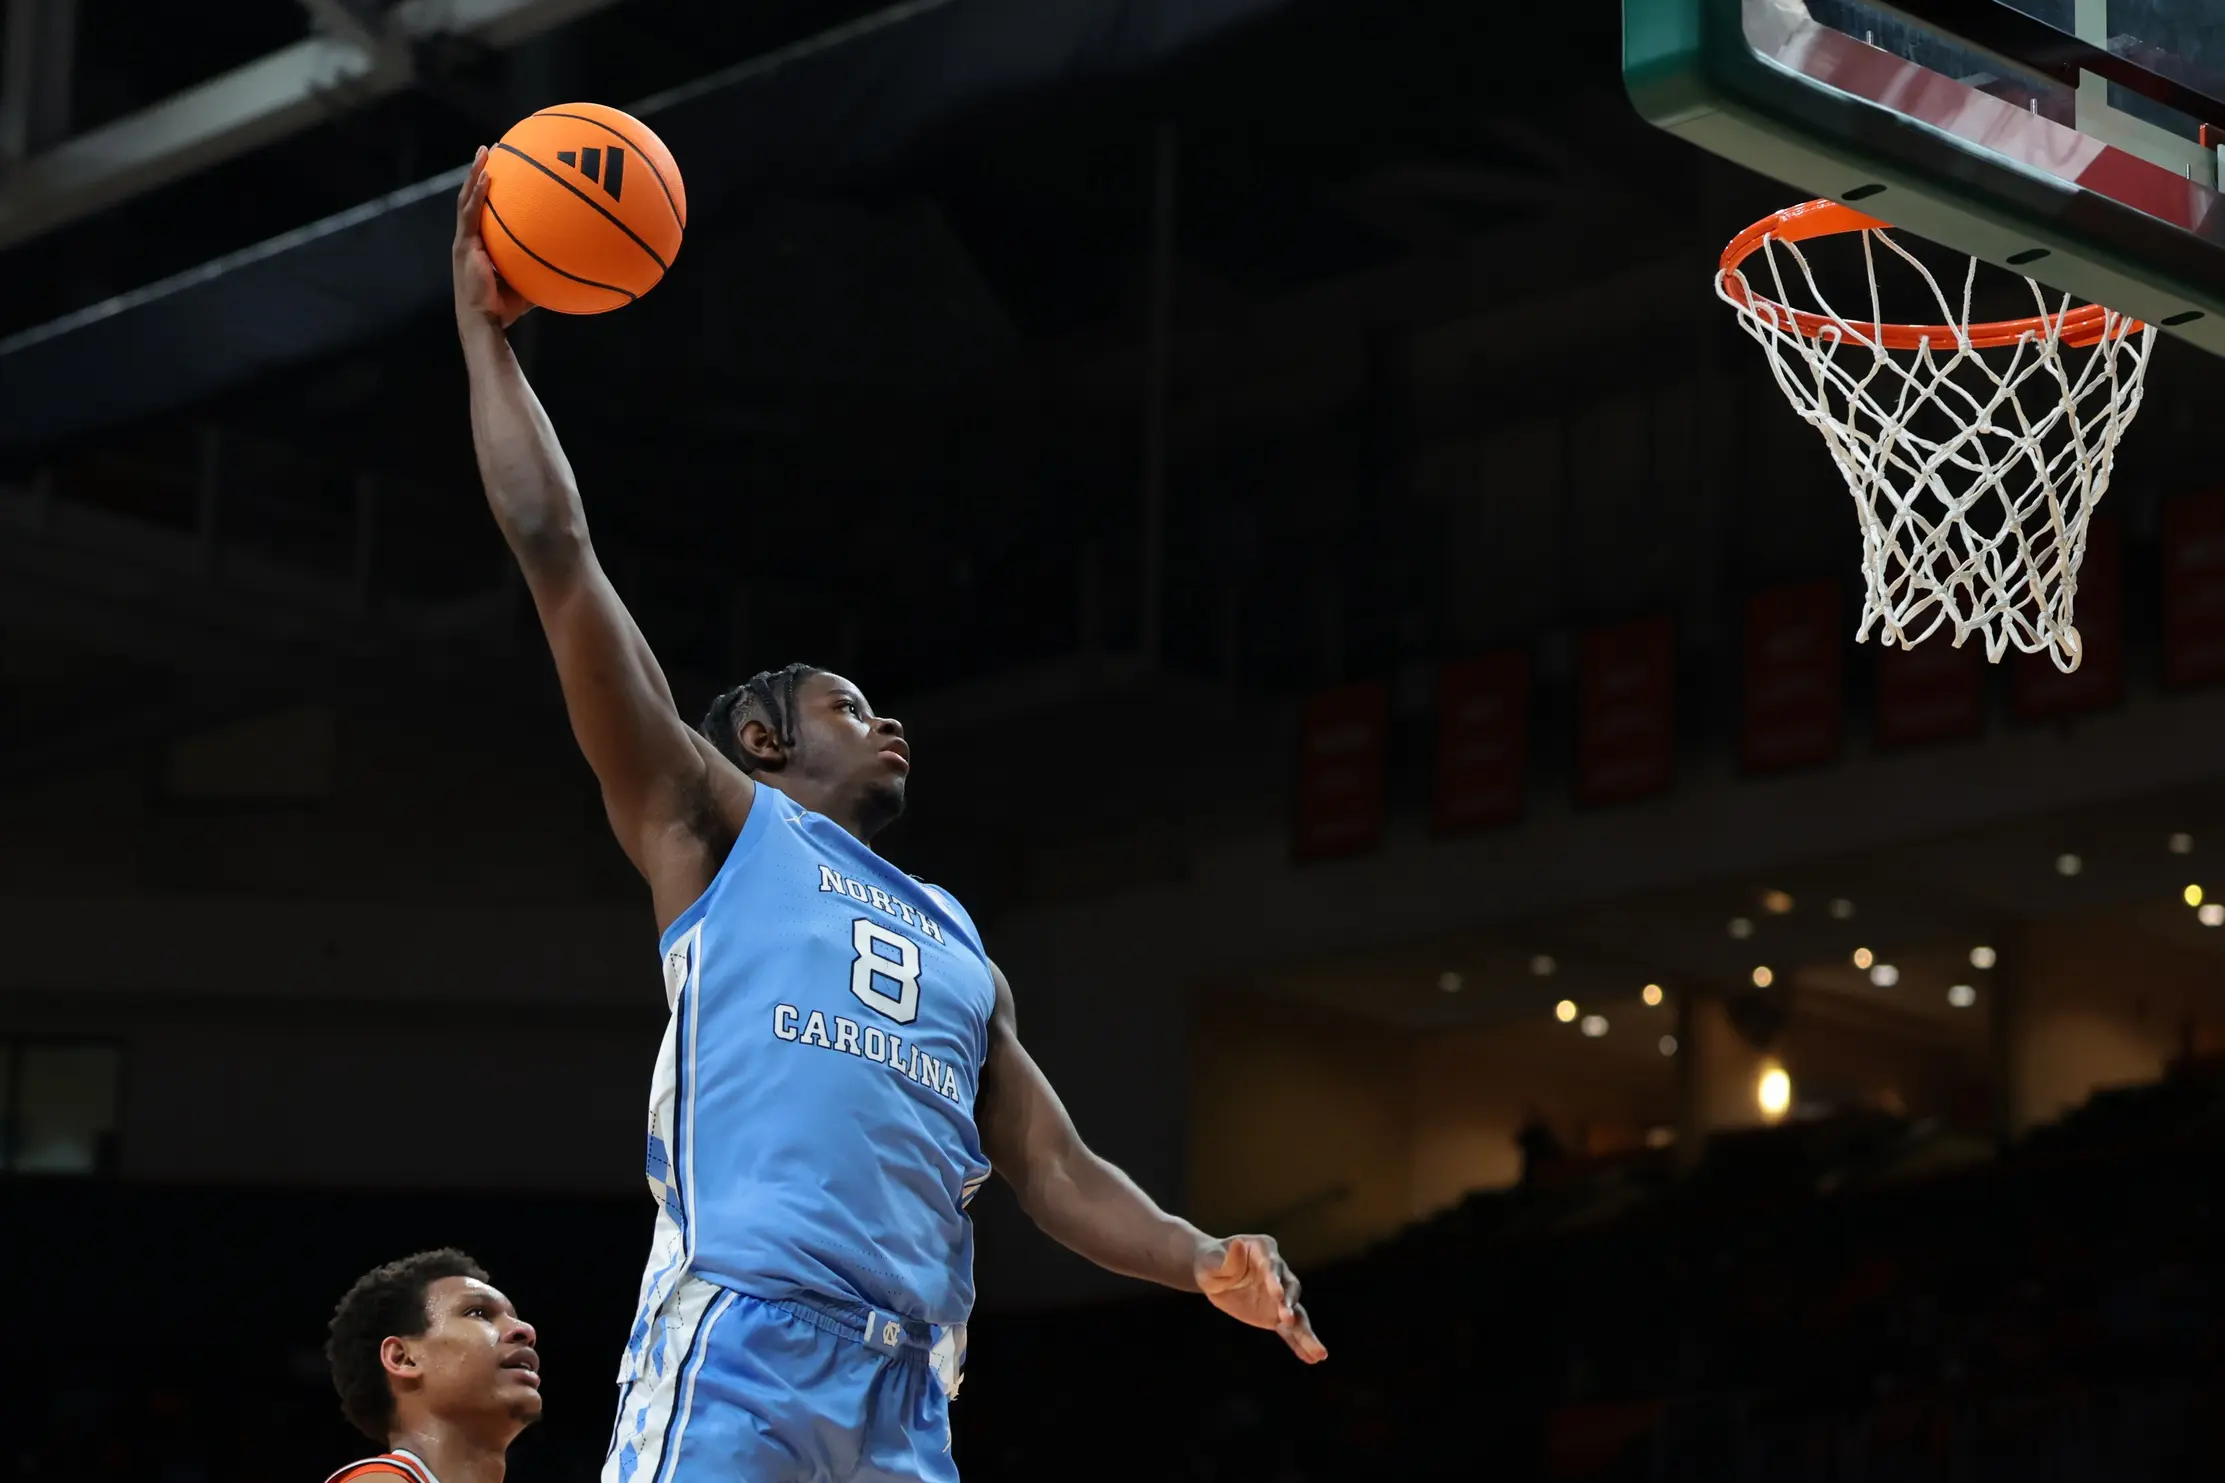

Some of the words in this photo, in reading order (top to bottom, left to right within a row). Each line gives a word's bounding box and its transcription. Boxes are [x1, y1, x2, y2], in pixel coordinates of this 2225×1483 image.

[818, 864, 946, 946] NORTH
[850, 917, 922, 1026] 8
[773, 1003, 960, 1104] CAROLINA
